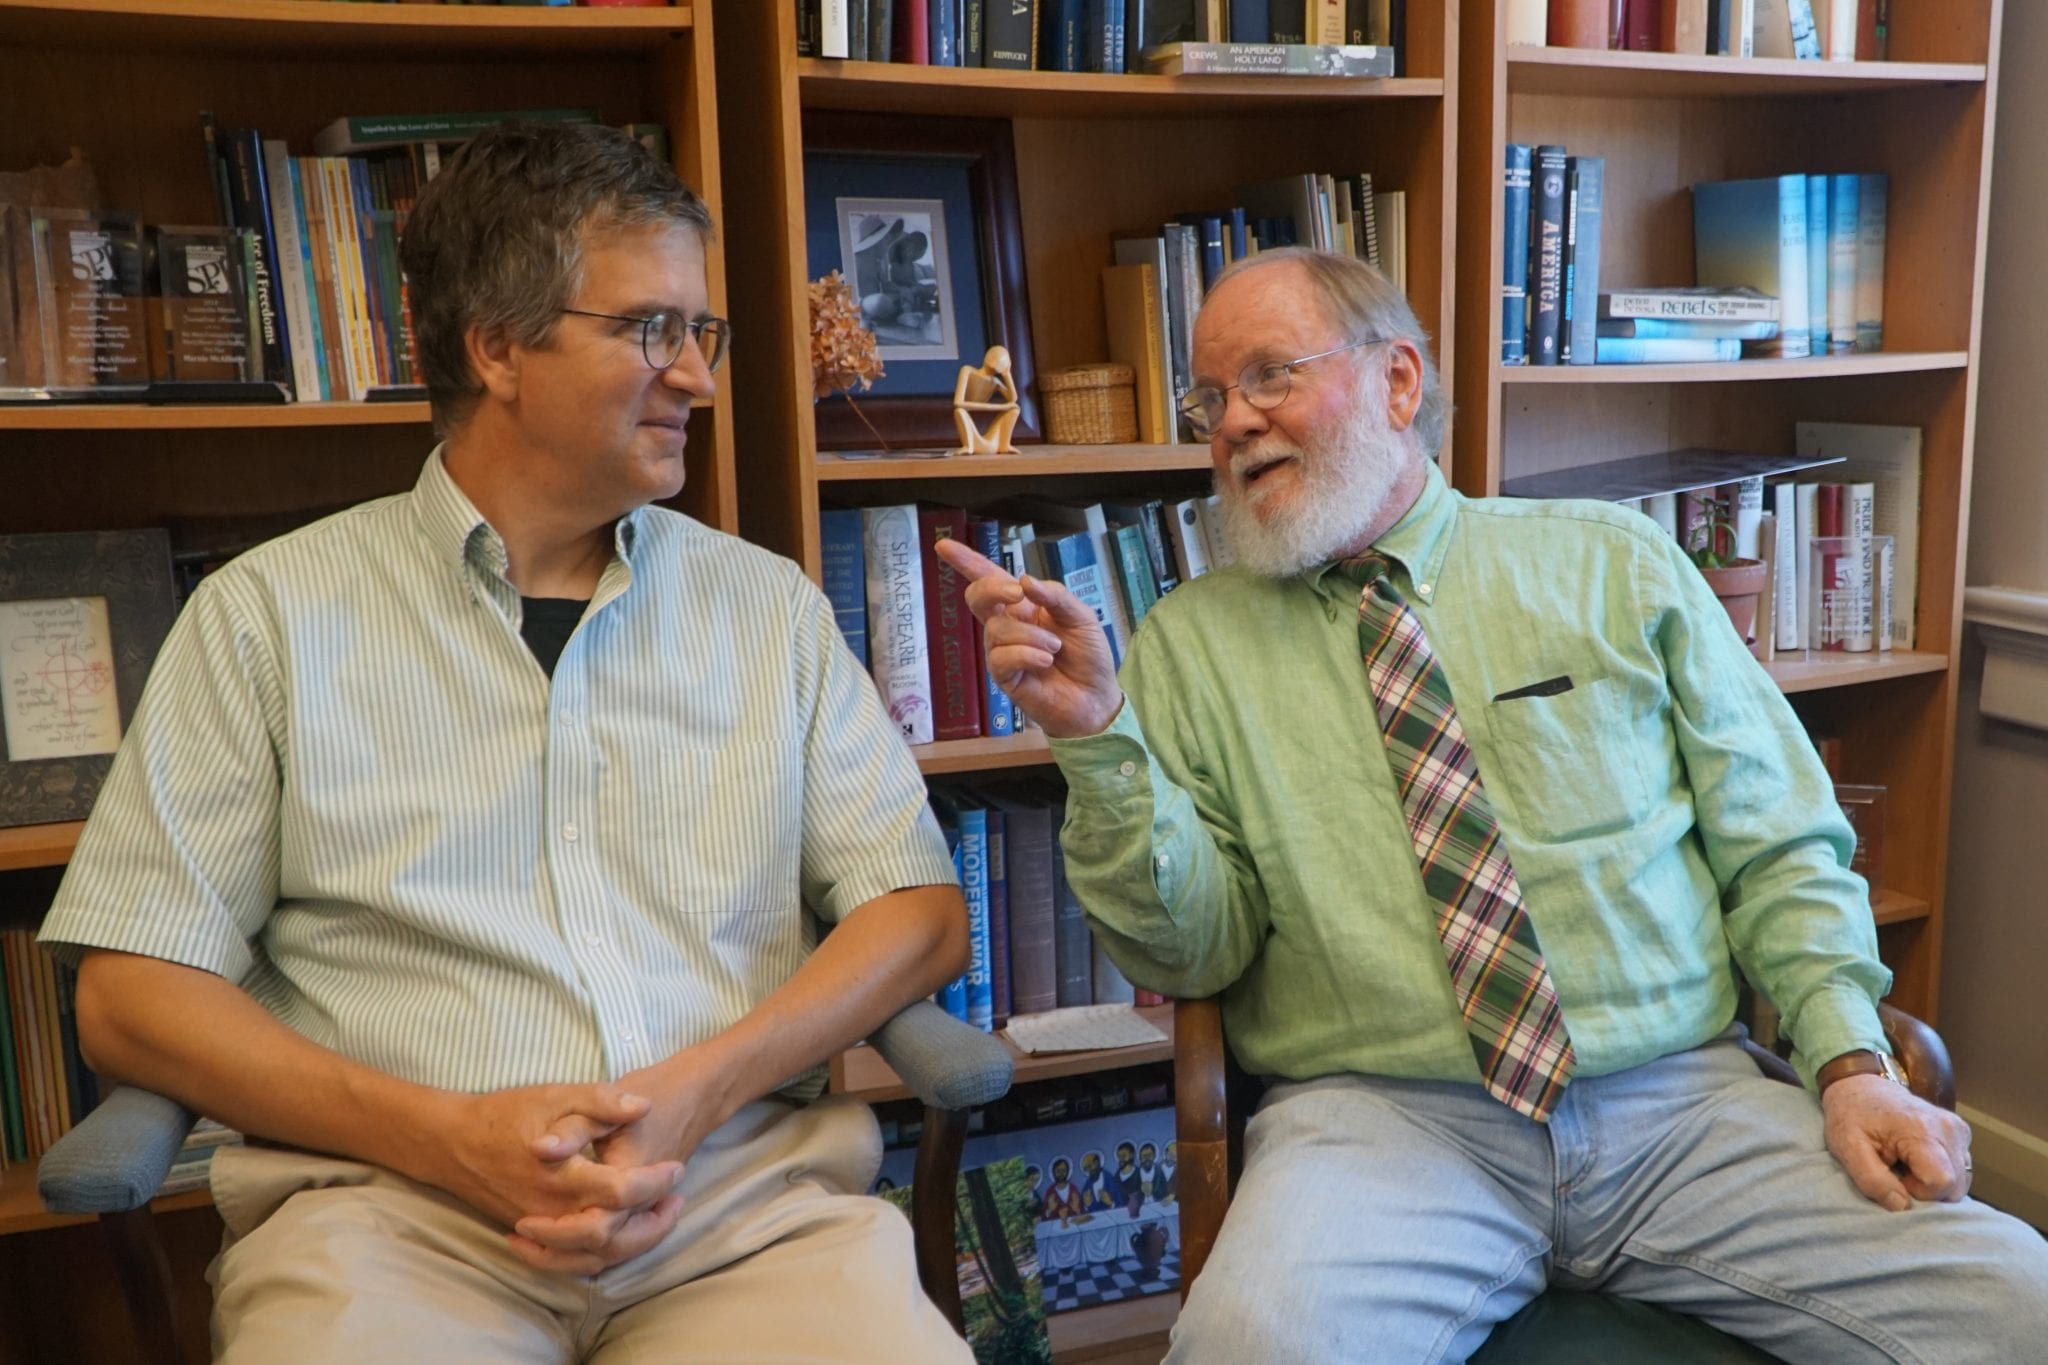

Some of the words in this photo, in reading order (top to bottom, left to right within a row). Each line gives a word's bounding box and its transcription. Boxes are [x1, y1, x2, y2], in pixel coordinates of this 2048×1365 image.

[993, 51, 1028, 61] KENTUCKY
[1104, 24, 1112, 63] CREWS
[1115, 25, 1124, 64] CREWS
[1189, 51, 1218, 61] CREWS
[1230, 47, 1242, 55] AN
[1244, 47, 1286, 56] AMERICAN
[1235, 55, 1257, 64] HOLY
[1258, 56, 1282, 65] LAND
[1540, 220, 1559, 313] AMERICA
[258, 277, 276, 346] Freedoms
[1862, 497, 1871, 535] PRIDE
[935, 525, 960, 629] RDYARD
[892, 541, 916, 667] SHAKESPEARE
[892, 681, 917, 689] BLOOM
[943, 634, 965, 718] KIPLING
[963, 834, 982, 932] MODERN
[968, 935, 983, 985] WAR
